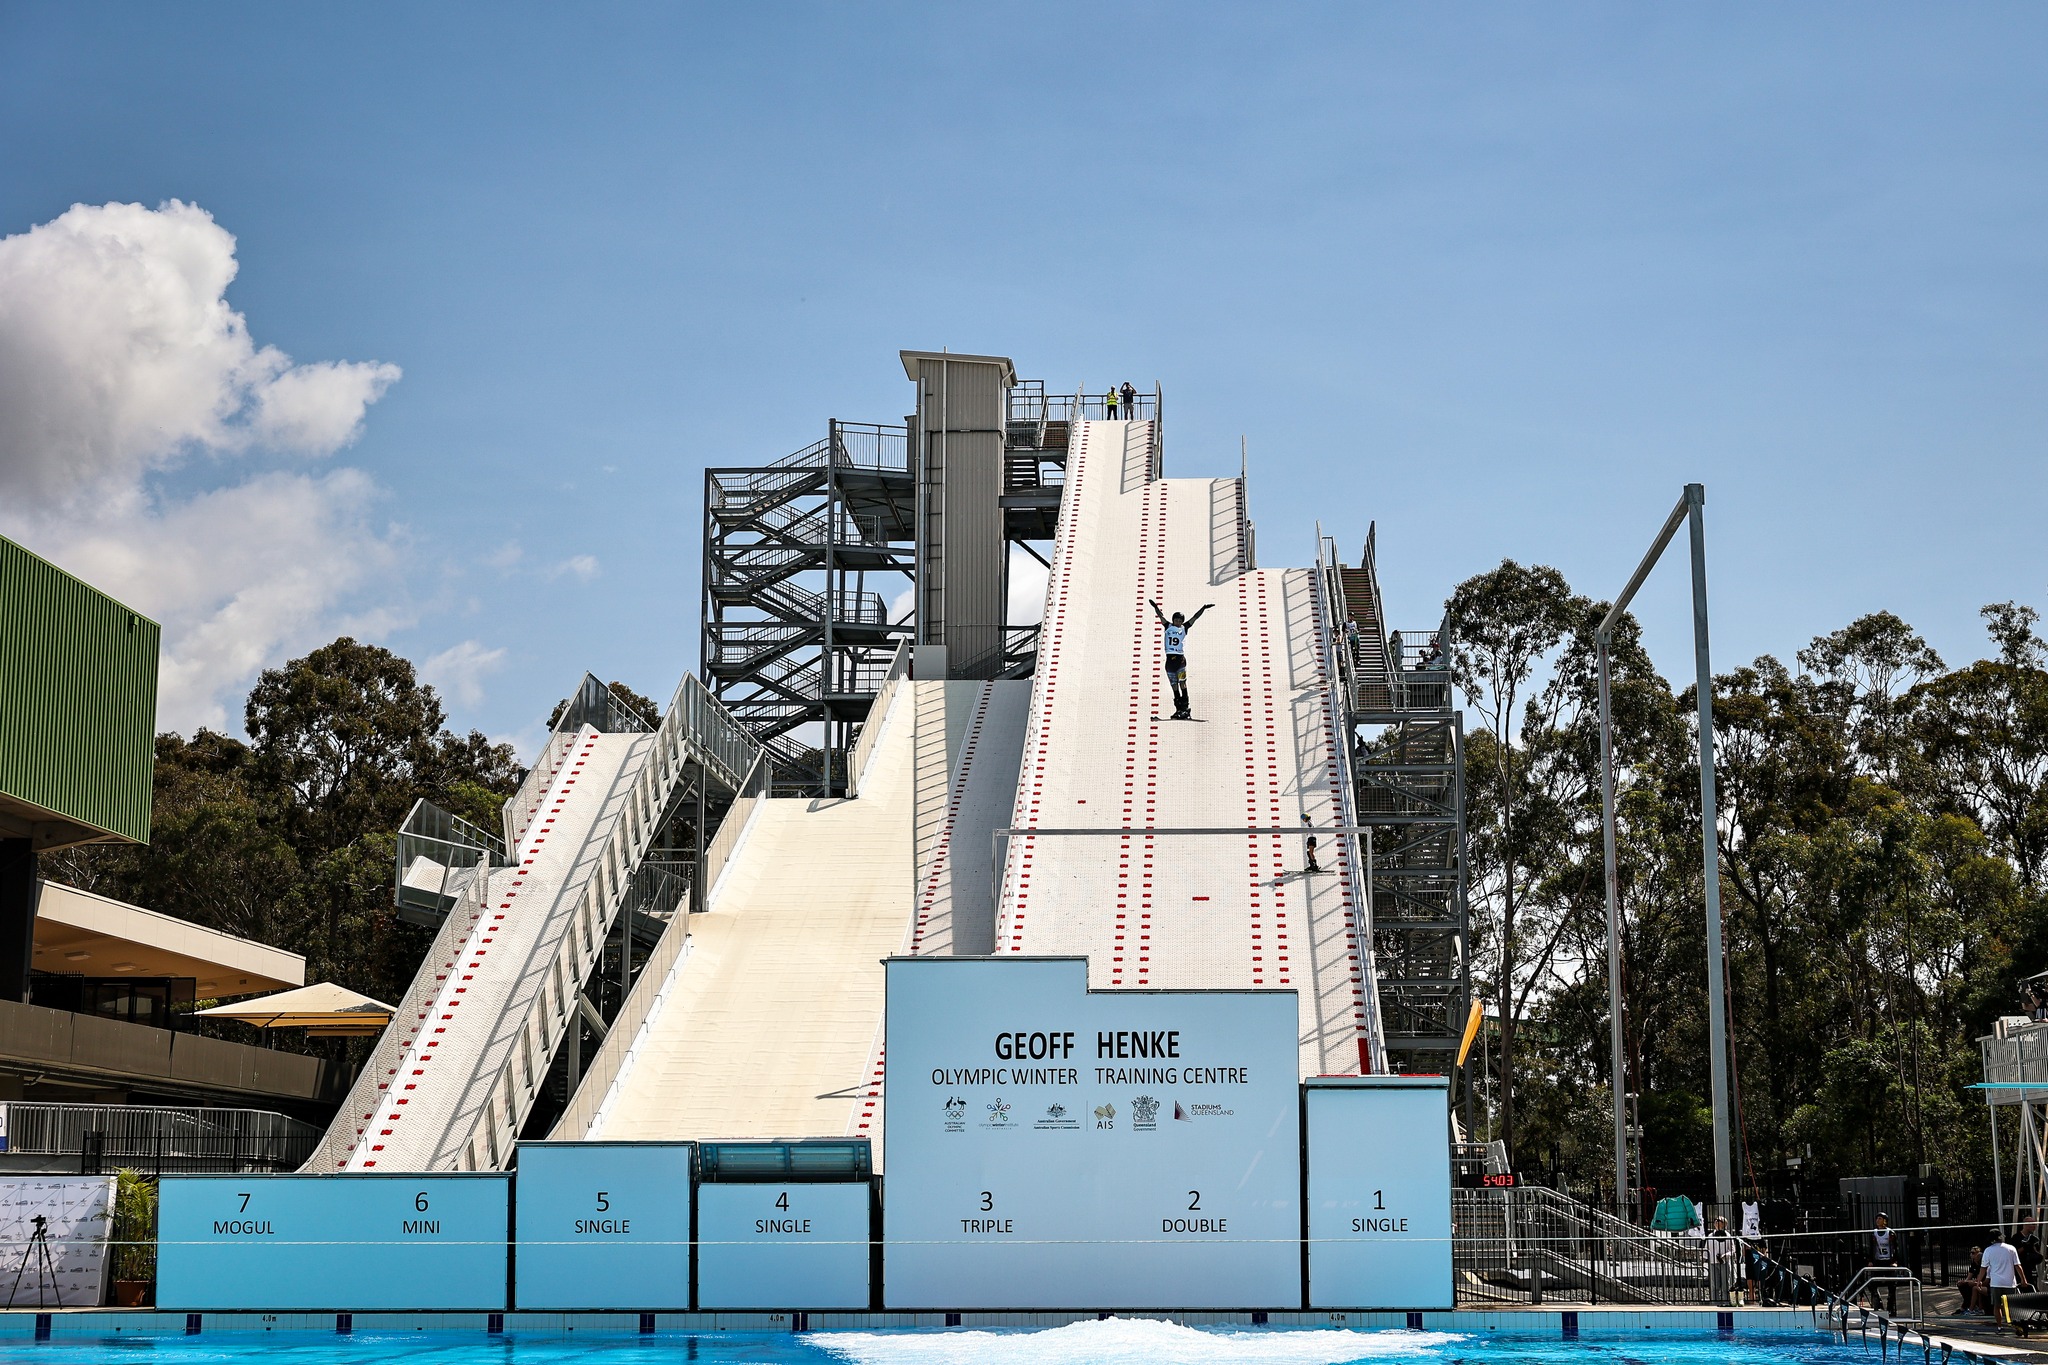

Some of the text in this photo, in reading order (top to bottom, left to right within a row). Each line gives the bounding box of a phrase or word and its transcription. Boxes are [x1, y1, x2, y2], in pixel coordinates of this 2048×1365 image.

[1168, 636, 1180, 647] 19
[994, 1030, 1180, 1061] GEOFF HENKE
[931, 1067, 1249, 1086] OLYMPIC WINTER TRAINING CENTRE
[1096, 1120, 1114, 1130] AIS
[237, 1193, 251, 1213] 7
[415, 1191, 429, 1213] 6
[596, 1191, 610, 1213] 5
[774, 1191, 790, 1213] 4
[979, 1190, 994, 1212] 3
[1187, 1190, 1202, 1211] 2
[1373, 1189, 1386, 1211] 1
[213, 1220, 275, 1235] MOGUL
[402, 1220, 441, 1234] MINI
[574, 1219, 631, 1234] SINGLE
[755, 1219, 811, 1234] SINGLE
[960, 1219, 1014, 1234] TRIPLE
[1162, 1218, 1228, 1233] DOUBLE
[1351, 1218, 1409, 1233] SINGLE
[262, 1314, 277, 1322] 4.0m
[769, 1314, 785, 1322] 4.0m
[1330, 1313, 1346, 1321] 4.0m
